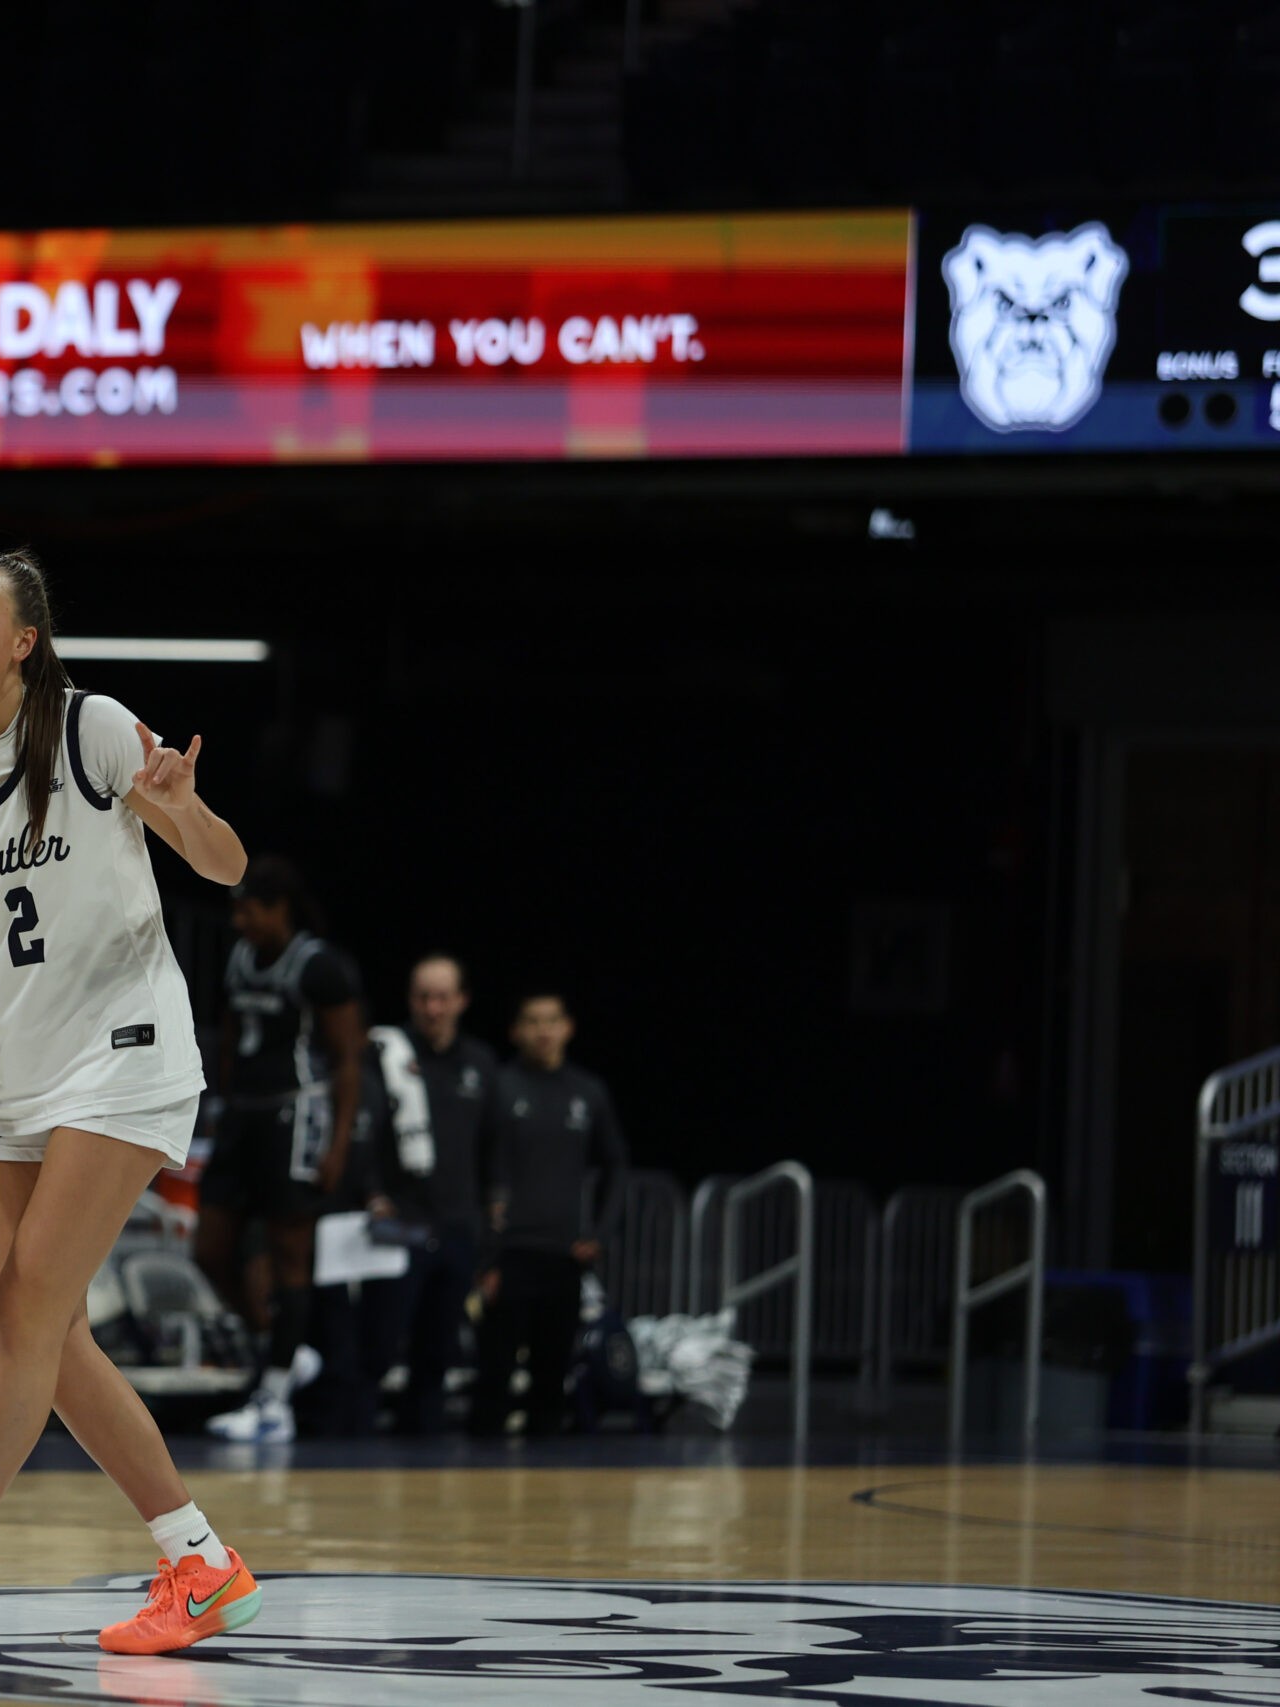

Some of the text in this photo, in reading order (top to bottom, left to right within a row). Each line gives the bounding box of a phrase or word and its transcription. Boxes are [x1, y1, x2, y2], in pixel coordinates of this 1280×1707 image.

[300, 312, 706, 369] WHEN YOU CAN'T.
[1156, 350, 1239, 382] BONUS
[4, 885, 45, 968] 2
[142, 1030, 151, 1040] M
